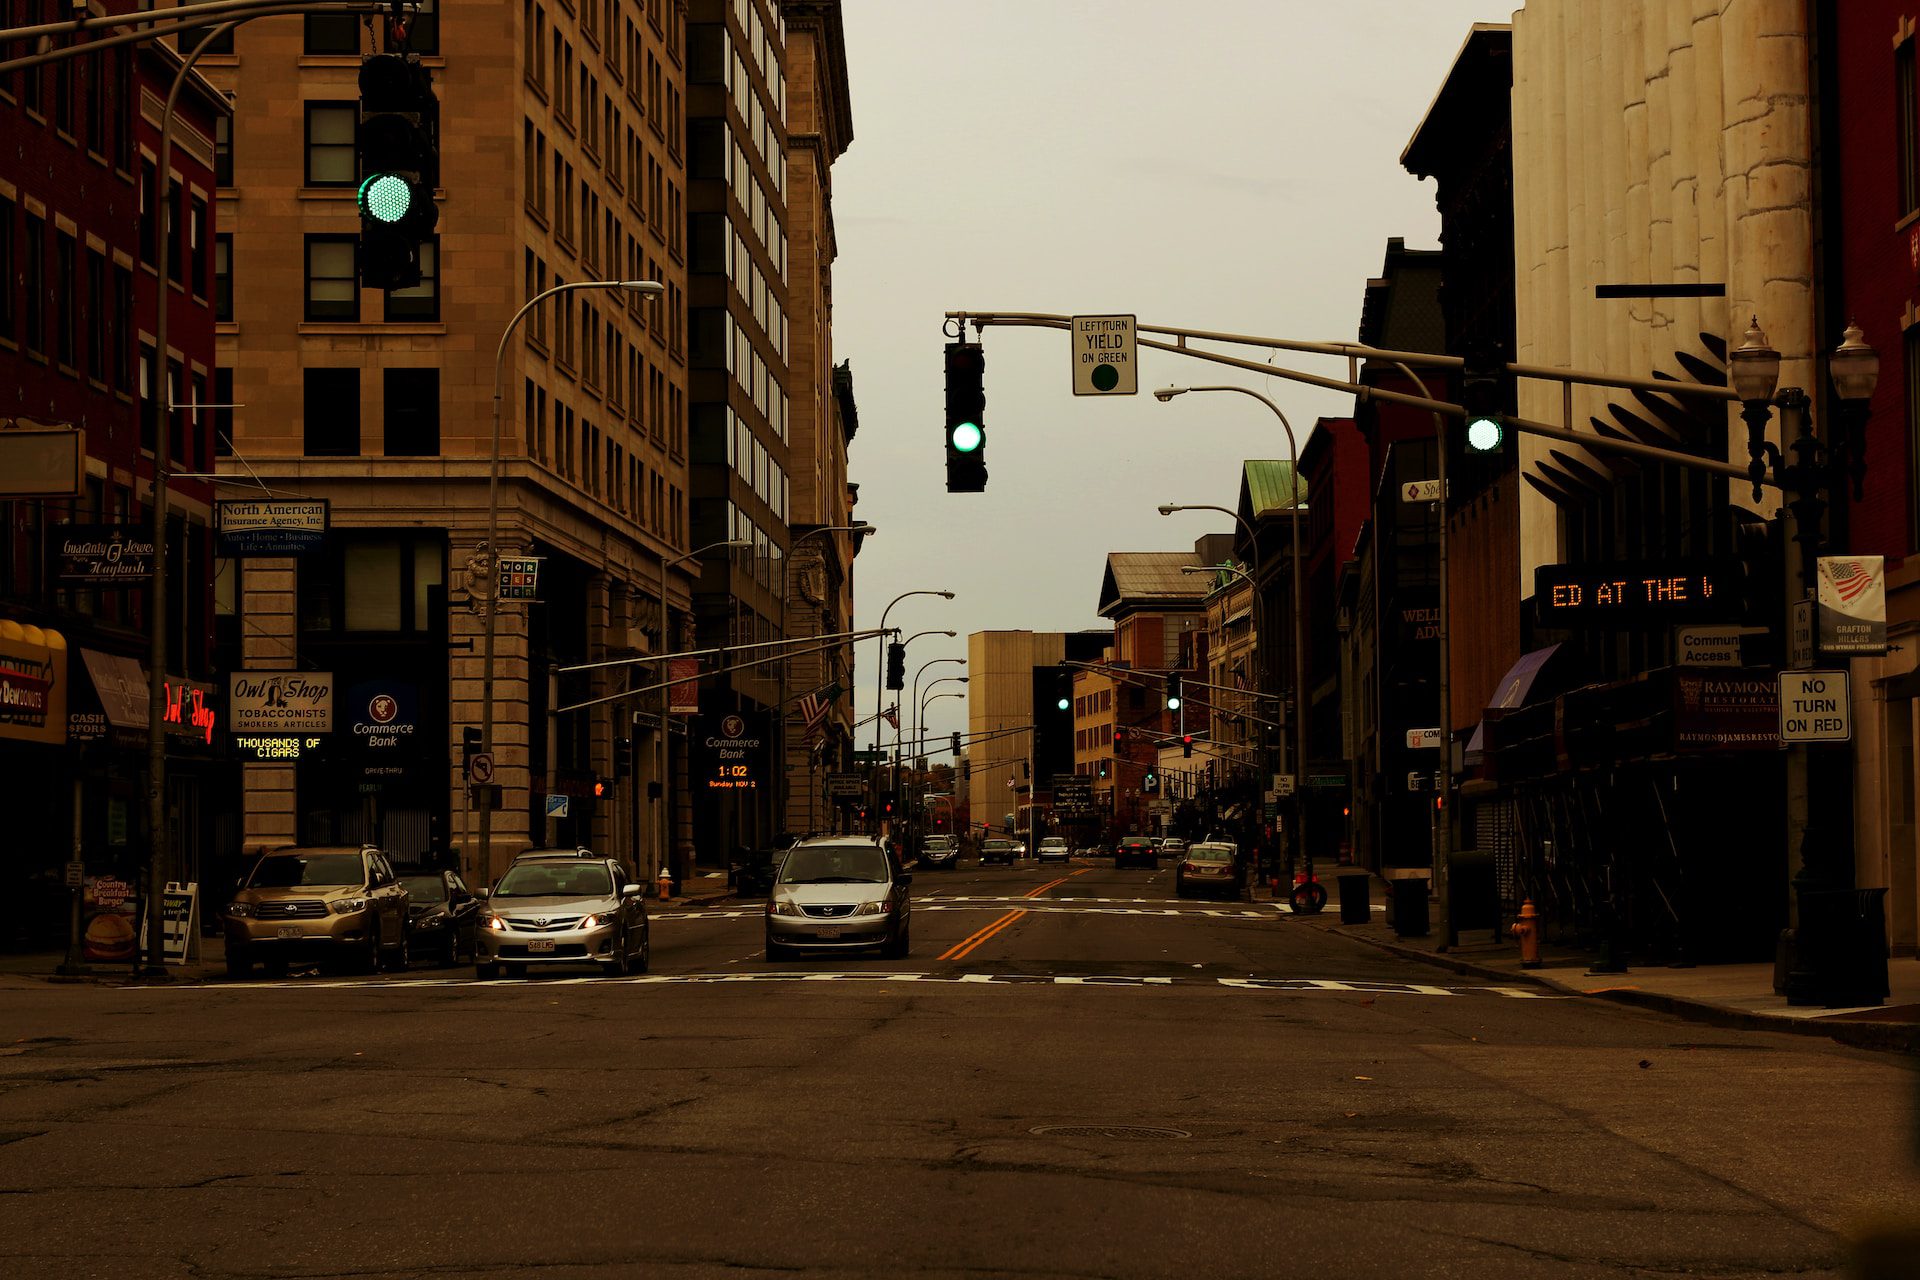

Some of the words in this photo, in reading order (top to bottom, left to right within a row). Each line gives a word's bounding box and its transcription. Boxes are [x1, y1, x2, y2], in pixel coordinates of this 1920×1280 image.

[1080, 321, 1101, 331] LEFT
[1106, 320, 1127, 331] TURN
[1086, 334, 1123, 349] YIELD
[1082, 353, 1094, 363] ON
[1098, 352, 1127, 363] GREEN
[223, 504, 259, 515] North
[264, 504, 323, 515] American
[223, 516, 267, 525] Insurance
[270, 517, 304, 527] Agency,
[307, 517, 323, 525] Inc.
[224, 533, 246, 542] Auto
[252, 532, 278, 541] Home
[285, 533, 322, 541] Business
[240, 543, 259, 551] Life
[265, 543, 306, 551] Annuities
[1553, 584, 1582, 607] ED
[1597, 581, 1626, 605] AT
[1642, 577, 1687, 602] THE
[1836, 625, 1872, 633] GRAFTON
[1838, 635, 1870, 643] HILLERS
[1685, 650, 1731, 661] Access
[235, 679, 267, 697] Owl
[284, 680, 329, 705] Shop
[1802, 680, 1826, 693] NO
[1793, 699, 1836, 713] TURN
[70, 713, 105, 723] CASH
[238, 709, 326, 718] TOBACCONISTS
[353, 722, 414, 734] Commerce
[1786, 719, 1807, 733] ON
[1814, 718, 1843, 732] RED
[236, 738, 300, 748] THOUSANDS
[305, 738, 321, 748] OF
[368, 735, 398, 747] Bank
[706, 736, 760, 748] Commerce
[257, 748, 300, 758] CIGARS
[720, 748, 745, 759] Bank
[719, 765, 747, 777] 1:02
[98, 896, 125, 907] Burger
